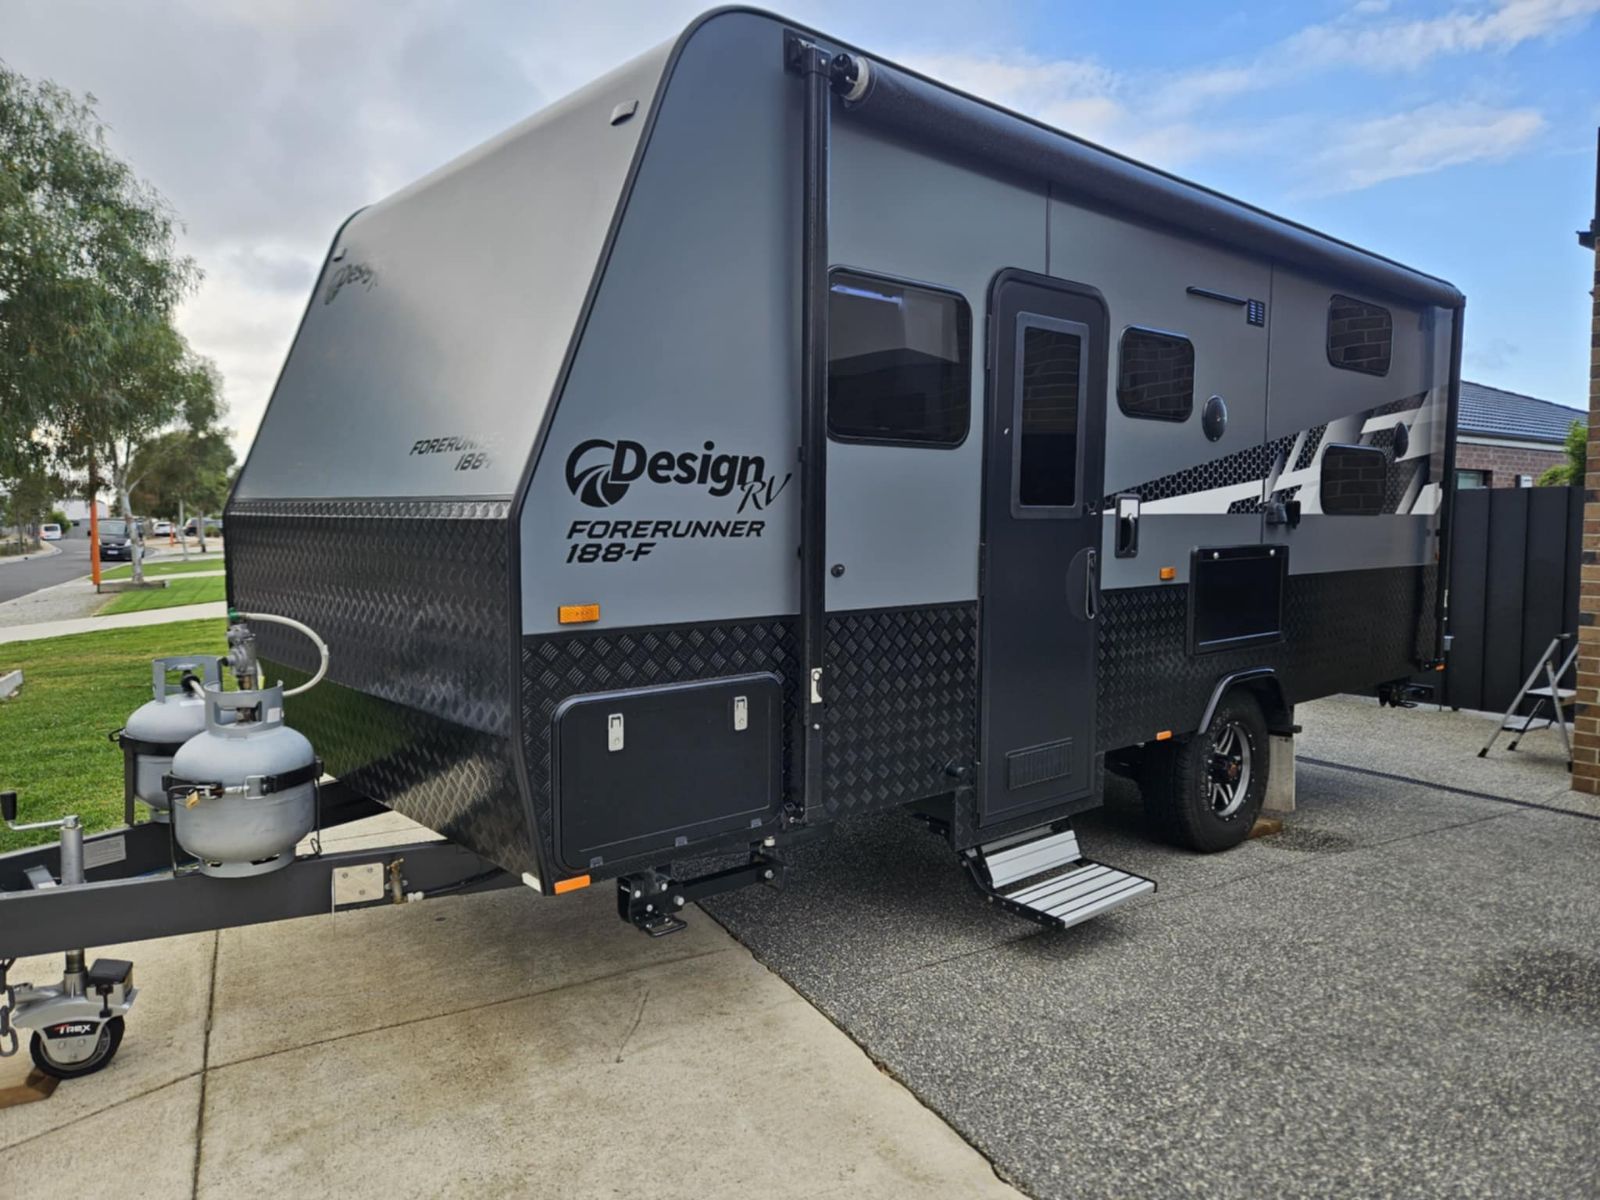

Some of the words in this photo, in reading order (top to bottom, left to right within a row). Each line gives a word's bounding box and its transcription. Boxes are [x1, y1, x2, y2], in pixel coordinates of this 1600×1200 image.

[610, 440, 766, 497] Design
[736, 473, 793, 514] RV
[566, 520, 766, 540] FORERUNNER
[566, 542, 657, 564] 188-F
